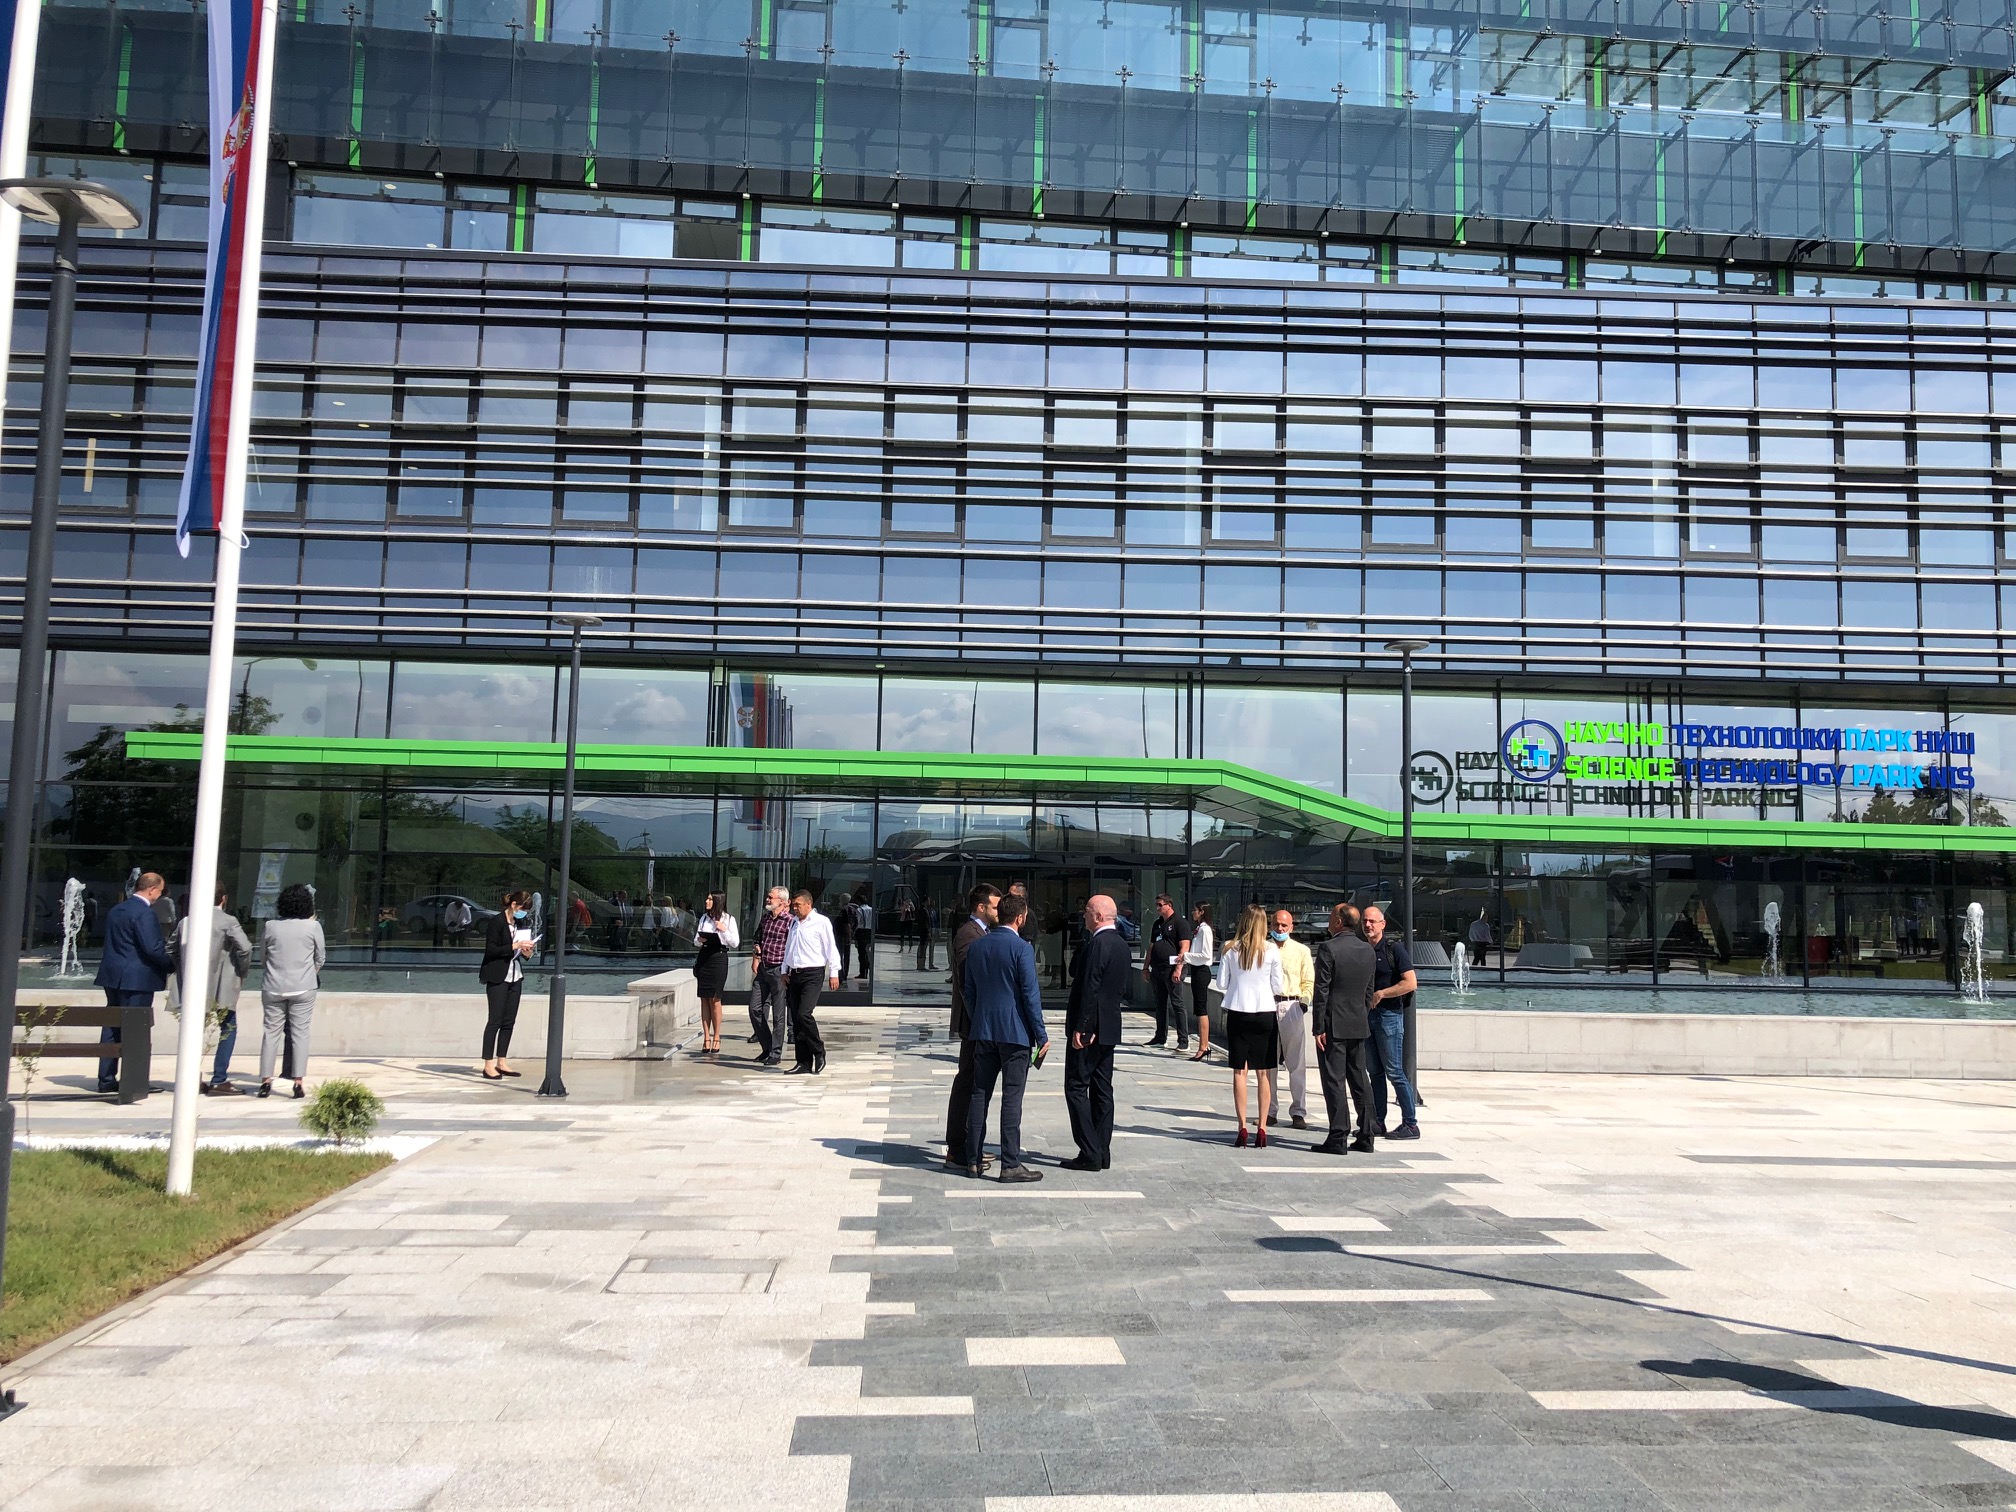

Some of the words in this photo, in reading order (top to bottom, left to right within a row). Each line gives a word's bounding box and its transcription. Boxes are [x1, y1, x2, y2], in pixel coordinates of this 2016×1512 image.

[1565, 721, 1663, 746] НАУЧНО
[1672, 724, 1841, 750] ТЕХНОЛОШКИ
[1845, 728, 1912, 752] ПАРК
[1916, 730, 1975, 754] НИШ
[1565, 755, 1675, 781] SCIENCE
[1682, 759, 1846, 786] TECHNOLOGY
[1852, 764, 1923, 788] PARK
[1929, 766, 1975, 790] NIS
